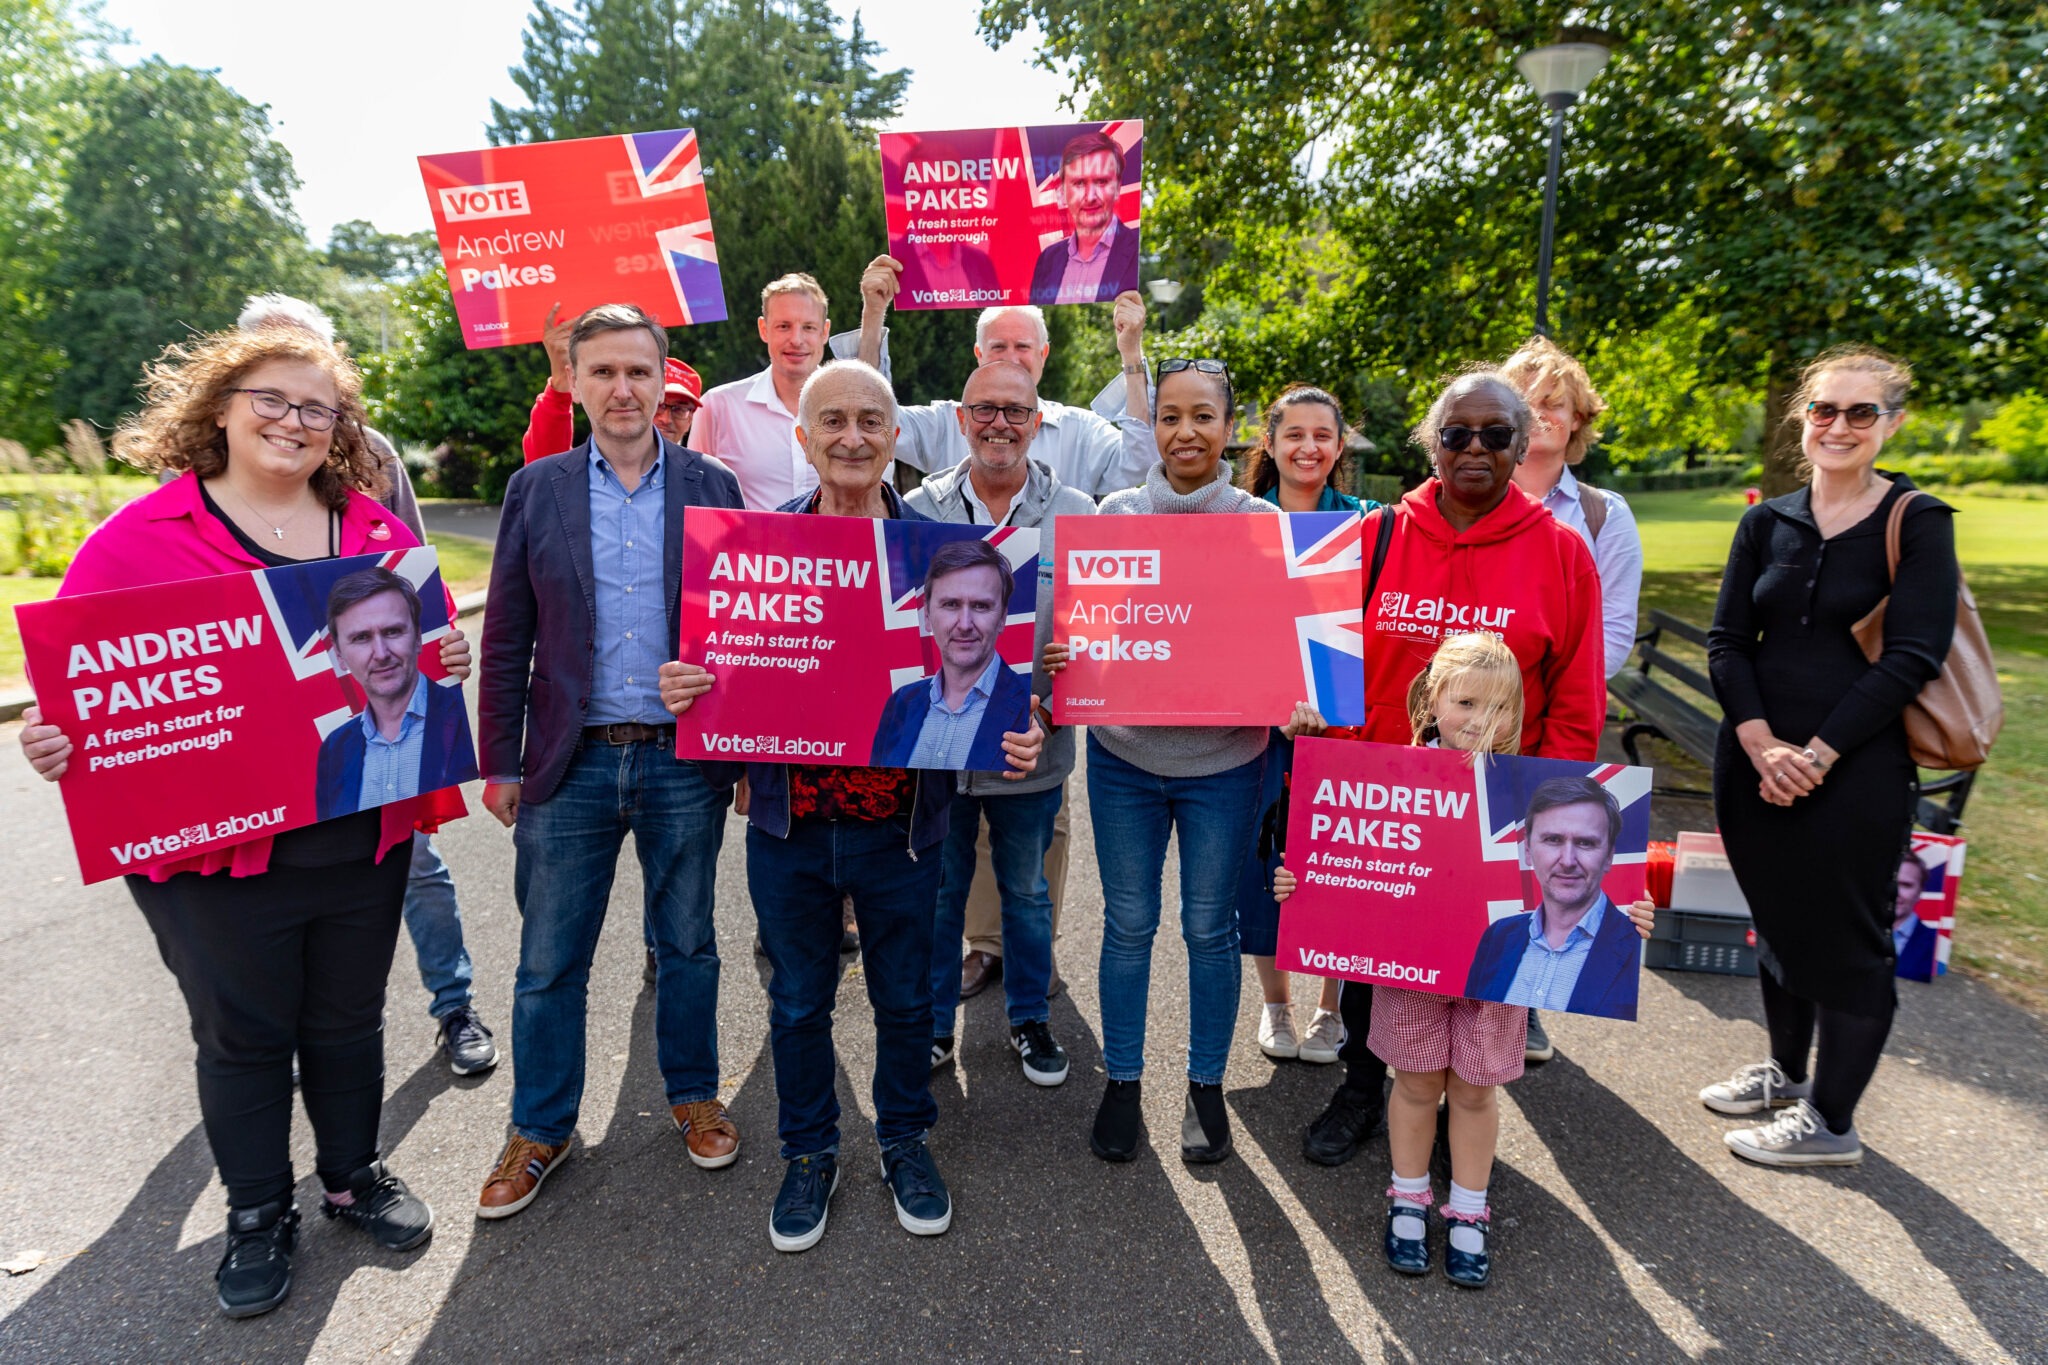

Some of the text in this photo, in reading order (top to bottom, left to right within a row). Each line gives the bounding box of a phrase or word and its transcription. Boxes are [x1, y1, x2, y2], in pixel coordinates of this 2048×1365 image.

[903, 157, 1020, 184] ANDREW
[446, 187, 523, 216] VOTE
[905, 186, 989, 211] PAKES
[906, 215, 999, 230] A fresh start for
[455, 228, 565, 260] Andrew
[907, 231, 989, 245] Peterborough
[460, 263, 556, 292] Pakes
[911, 287, 1012, 304] Vote Labour
[482, 321, 510, 332] Labour
[708, 552, 872, 589] ANDREW
[1074, 556, 1153, 579] VOTE
[708, 590, 824, 624] PAKES
[1068, 597, 1192, 625] Andrew
[1399, 593, 1516, 629] Labour
[1375, 618, 1397, 631] and
[67, 614, 263, 679] ANDREW
[705, 630, 836, 651] A fresh start for
[1068, 633, 1171, 661] Pakes
[704, 650, 820, 674] Peterborough
[72, 664, 224, 721] PAKES
[1074, 697, 1106, 706] Labour
[84, 703, 245, 750] A fresh start for
[88, 727, 233, 773] Peterborough
[701, 732, 847, 758] Vote Labour
[1312, 778, 1471, 820] ANDREW
[110, 805, 288, 865] Vote Labour
[1310, 813, 1422, 852] PAKES
[1306, 851, 1433, 879] A fresh start for
[1304, 870, 1417, 898] Peterborough
[1298, 947, 1441, 985] Vote Labour
